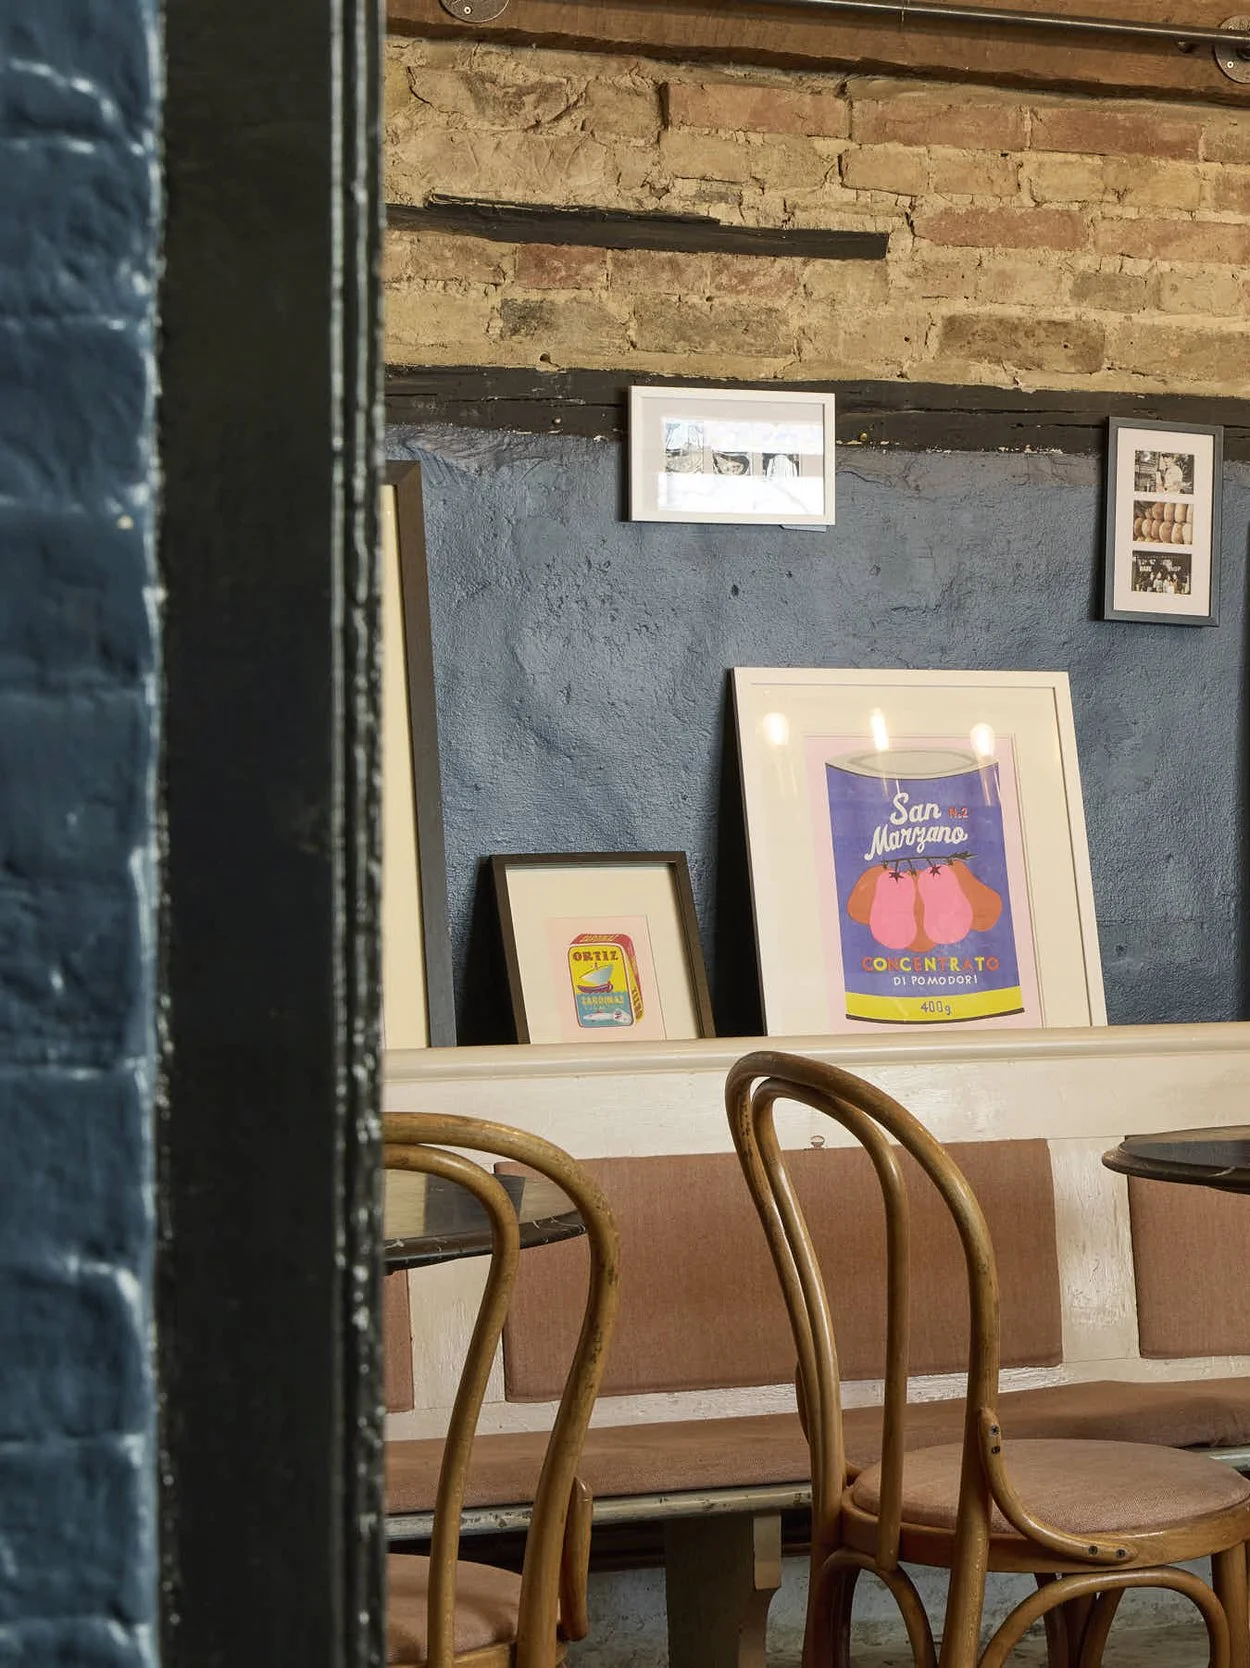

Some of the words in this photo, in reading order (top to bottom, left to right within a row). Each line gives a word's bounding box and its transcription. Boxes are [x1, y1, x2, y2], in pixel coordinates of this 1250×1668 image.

[890, 792, 942, 825] San
[864, 823, 968, 861] Marzano
[573, 950, 619, 961] ORTIZ
[862, 956, 1000, 972] CONCENTRATO
[893, 975, 906, 986] DI
[911, 974, 977, 986] POMODORI
[920, 1000, 951, 1016] 400g
